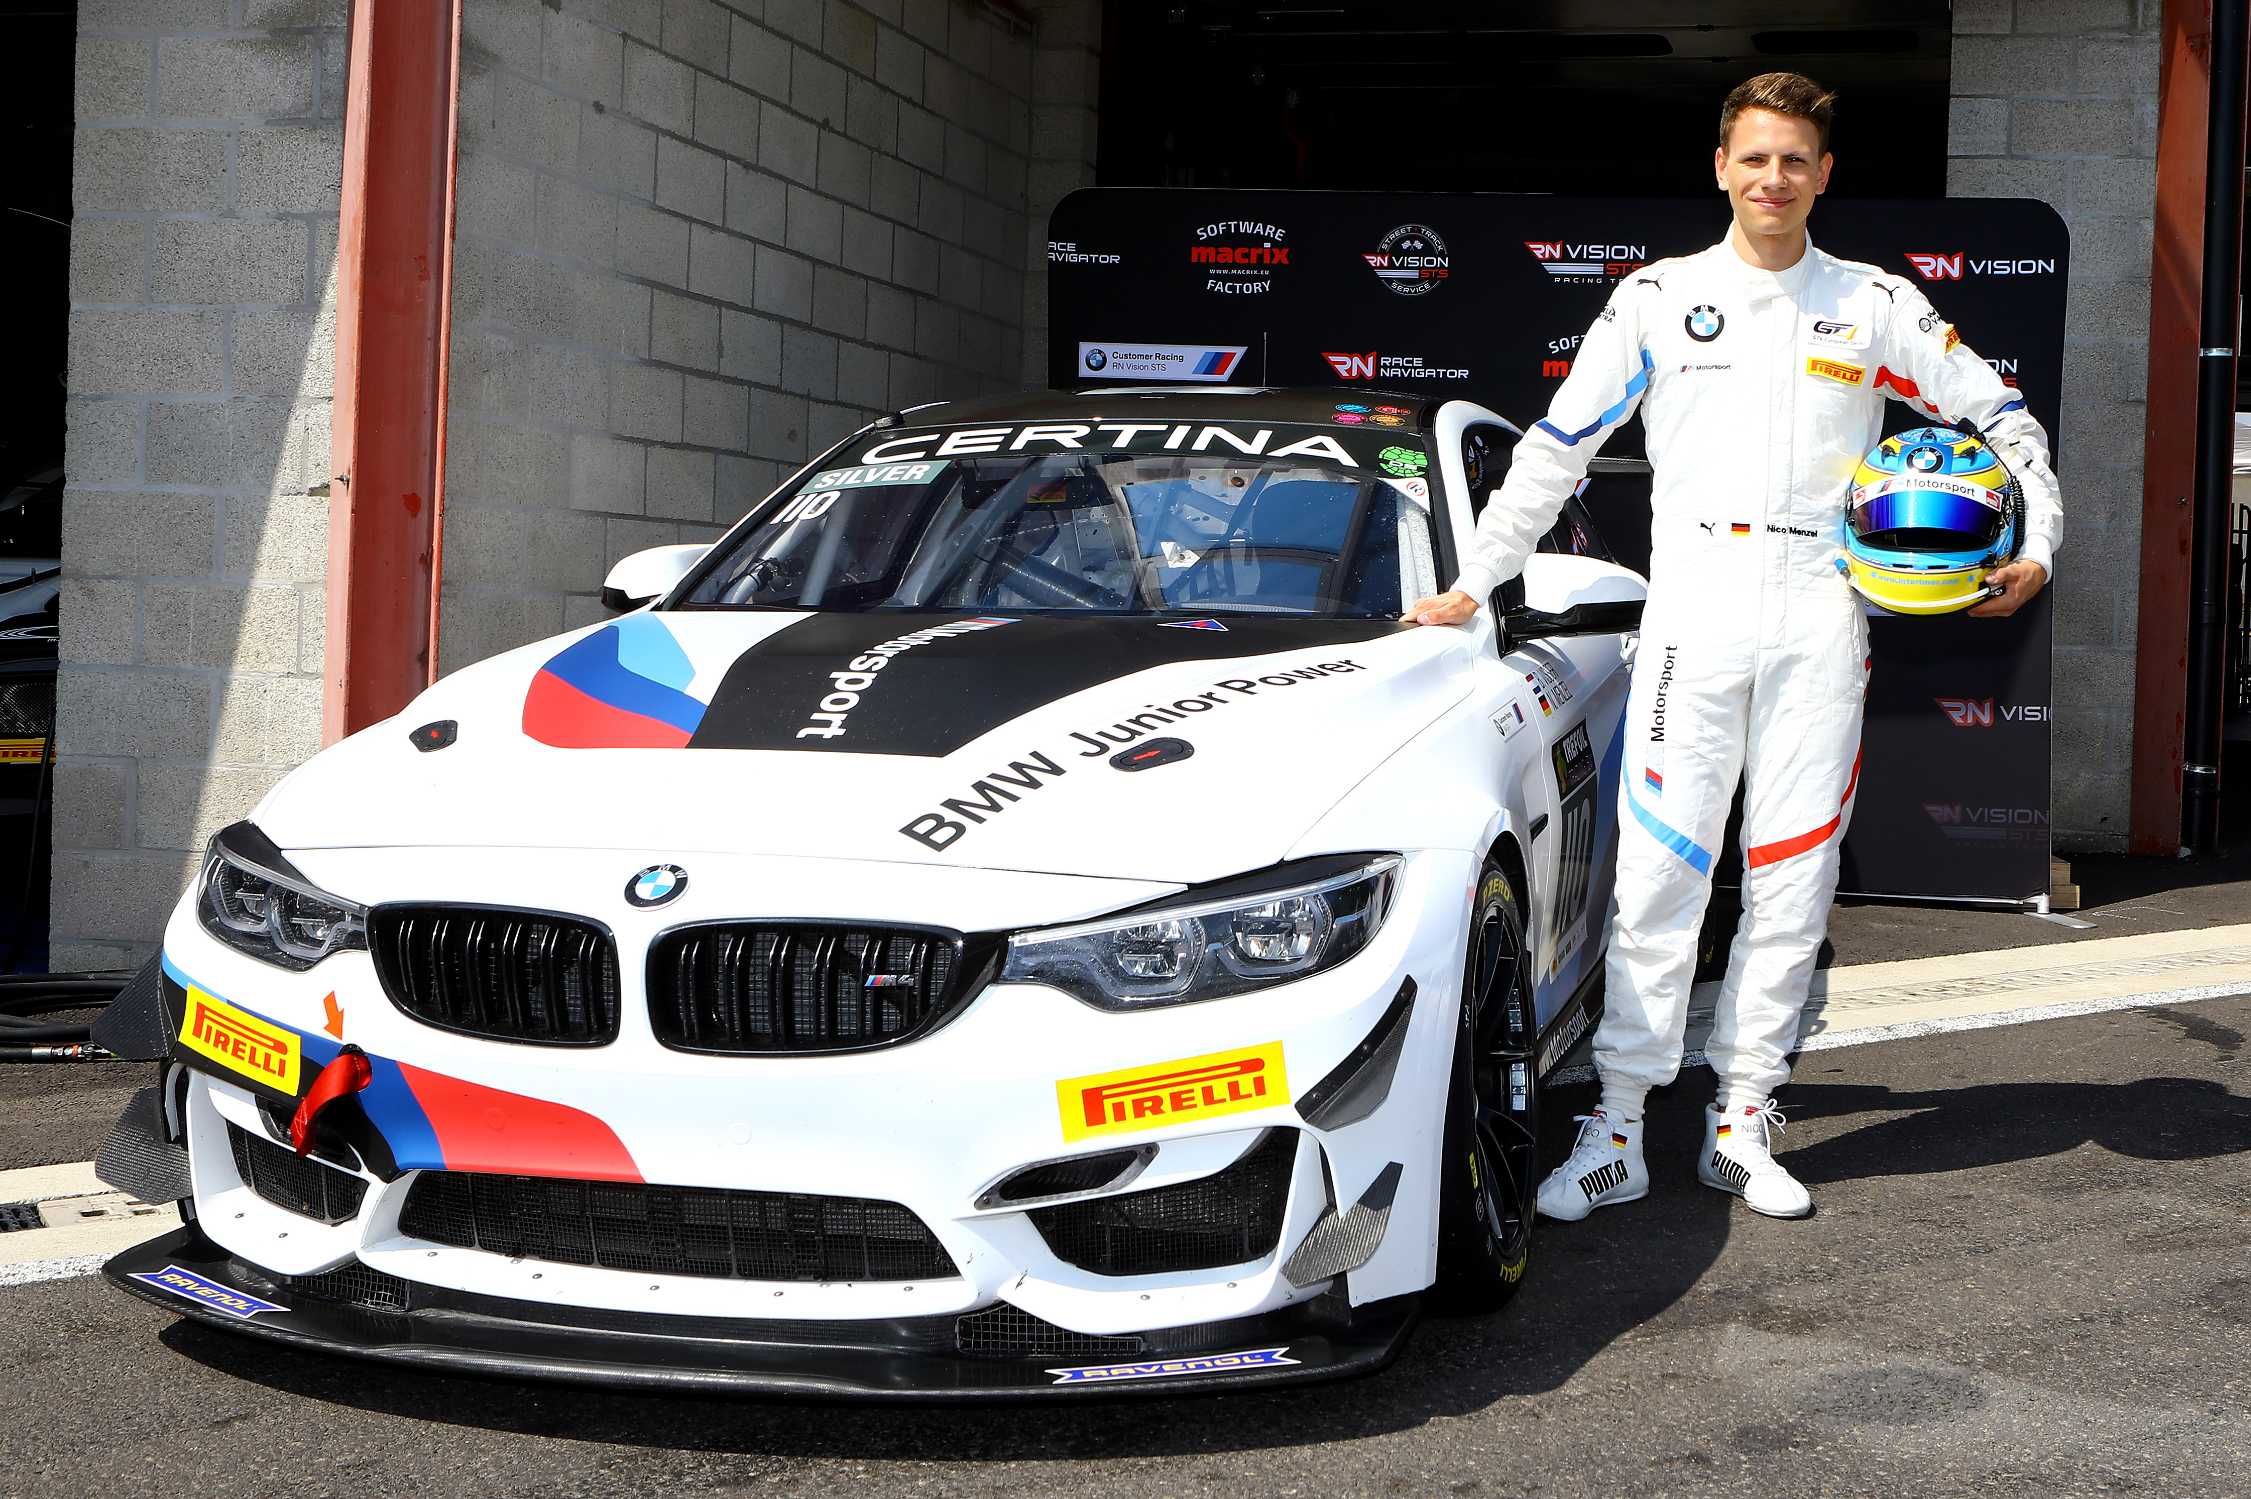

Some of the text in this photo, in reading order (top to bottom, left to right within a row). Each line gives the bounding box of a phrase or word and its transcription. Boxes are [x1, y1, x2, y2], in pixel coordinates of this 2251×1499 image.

[1196, 221, 1286, 241] SOFTWARE
[1381, 226, 1444, 252] STREET TRACK
[1048, 241, 1077, 252] ACE
[1190, 242, 1290, 265] macrix
[1527, 243, 1646, 260] RN VISION
[1048, 252, 1121, 264] AVIGATOR
[1362, 255, 1449, 268] RN VISION
[1909, 255, 2055, 279] RN VISION
[1420, 269, 1449, 278] STS
[1206, 279, 1271, 294] FACTORY
[1391, 281, 1431, 293] SERVICE
[1112, 351, 1154, 361] Customer
[1155, 353, 1184, 363] Racing
[1112, 362, 1167, 371] RN Vision STS
[1326, 354, 1374, 377] RN
[1380, 357, 1423, 367] RACE
[1380, 367, 1469, 379] NAVIGATOR
[1811, 360, 1862, 382] PIRELLI
[862, 423, 1360, 467] CERTINA
[814, 464, 932, 489] SILVER
[1906, 478, 1976, 497] Motorsport
[769, 490, 841, 525] 110
[1766, 524, 1818, 538] Nico Menzel
[796, 629, 971, 739] Motorsport
[1650, 644, 1678, 742] Motorsport
[2000, 705, 2051, 722] VISI
[898, 656, 1368, 853] BMW Junior Power
[1966, 807, 2050, 825] VISION
[190, 1001, 289, 1079] PIRELLI
[1550, 1001, 1590, 1063] Motorsport
[1081, 1057, 1267, 1127] PIRELLI
[1577, 1158, 1629, 1204] PUMA
[1710, 1149, 1752, 1194] PUMA
[157, 1273, 256, 1311] RAVENOL
[1082, 1354, 1265, 1378] RAVENOL
